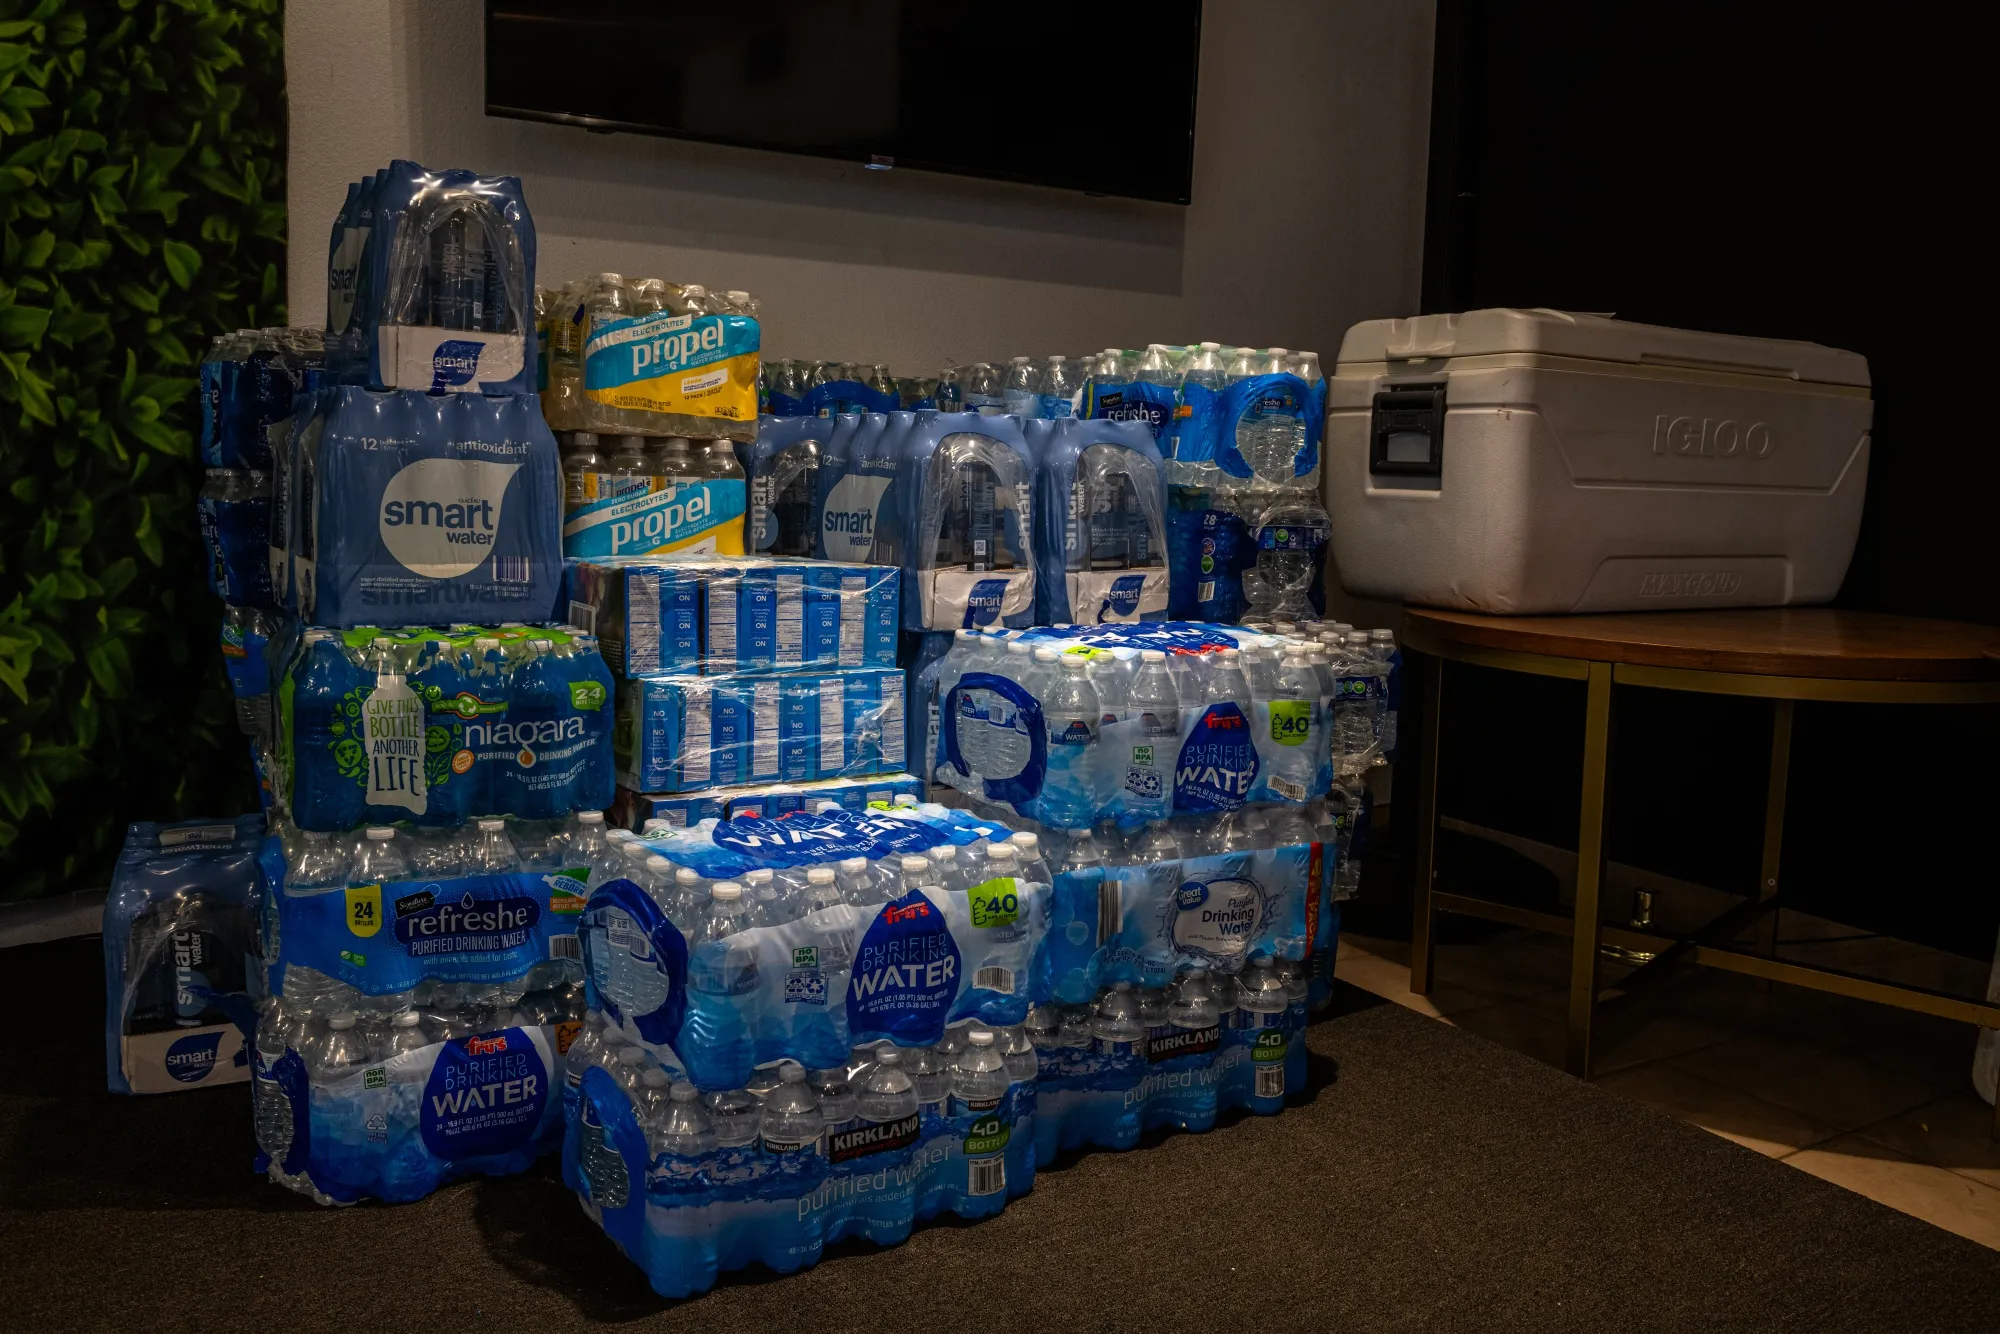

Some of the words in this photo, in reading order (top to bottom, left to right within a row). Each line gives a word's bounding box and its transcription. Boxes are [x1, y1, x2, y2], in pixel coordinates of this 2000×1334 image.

[631, 318, 725, 376] propel
[434, 355, 476, 370] smart
[361, 436, 379, 452] 12
[1653, 414, 1777, 460] IGLOO
[456, 440, 528, 455] antioxidant
[611, 496, 626, 505] ZERO
[626, 489, 648, 502] SUGAR
[766, 475, 776, 505] water
[1077, 480, 1086, 515] water
[611, 492, 670, 517] ELECTROLYTES
[752, 474, 768, 541] smart
[384, 499, 494, 531] smart
[609, 486, 713, 556] propel
[824, 508, 873, 534] smart
[1017, 481, 1031, 552] smart
[446, 530, 494, 546] water
[849, 534, 872, 548] water
[1639, 571, 1743, 598] MAXCOLD
[969, 594, 1001, 608] smart
[1110, 588, 1140, 601] smart
[575, 686, 601, 700] 24
[366, 699, 394, 714] GIVE
[397, 697, 419, 713] THIS
[653, 710, 666, 718] NO
[723, 707, 735, 715] NO
[370, 716, 420, 739] BOTTLE
[722, 725, 735, 733] NO
[792, 721, 804, 729] NO
[1282, 716, 1309, 733] 40
[465, 715, 586, 755] niagara
[1065, 733, 1091, 742] WATER
[373, 738, 420, 757] ANOTHER
[477, 752, 515, 761] PURIFIED
[539, 747, 572, 762] DRINKING
[572, 737, 596, 754] WATER
[722, 752, 734, 760] NO
[791, 748, 803, 756] NO
[1186, 743, 1251, 756] PURIFIED
[1135, 753, 1151, 761] BPA
[1184, 754, 1252, 770] DRINKING
[374, 756, 421, 797] LIFE
[1176, 760, 1255, 795] WATER
[722, 816, 908, 848] WATER
[553, 879, 584, 897] REBORN
[1179, 886, 1202, 900] Great
[399, 895, 429, 910] Signature
[985, 893, 1018, 914] 40
[1182, 895, 1202, 907] Value
[354, 902, 374, 920] 24
[407, 901, 528, 937] refreshe
[1202, 907, 1255, 923] Drinking
[1219, 920, 1254, 937] Water
[192, 932, 203, 966] water
[411, 937, 453, 956] PURIFIED
[455, 933, 499, 952] DRINKING
[499, 930, 526, 948] WATER
[864, 932, 947, 959] PURIFIED
[423, 956, 438, 966] with
[469, 953, 491, 963] added
[491, 952, 502, 962] for
[795, 955, 815, 963] BPA
[862, 944, 948, 972] DRINKING
[174, 931, 193, 1006] smart
[852, 955, 956, 1001] WATER
[916, 993, 926, 1001] 500
[464, 1035, 508, 1057] fry's
[1151, 1027, 1220, 1054] KIRKLAND
[1258, 1033, 1282, 1046] 40
[167, 1047, 215, 1066] smart
[365, 1069, 385, 1077] non
[446, 1053, 526, 1079] PURIFIED
[365, 1075, 385, 1084] BPA
[445, 1064, 529, 1091] DRINKING
[1124, 1069, 1191, 1110] purified
[1199, 1052, 1243, 1088] water
[432, 1074, 538, 1118] WATER
[970, 1098, 1001, 1109] KIRKLAND
[466, 1116, 473, 1125] OZ
[496, 1110, 506, 1120] 500
[515, 1103, 535, 1116] BOTTLES
[833, 1116, 919, 1152] KIRKLAND
[971, 1120, 999, 1136] 40
[765, 1140, 800, 1152] KIRKLAND
[968, 1134, 1009, 1150] BOTTLES
[798, 1167, 887, 1223] purified
[896, 1144, 954, 1187] water
[812, 1207, 833, 1225] with
[832, 1195, 873, 1213] minerals
[875, 1189, 905, 1204] added
